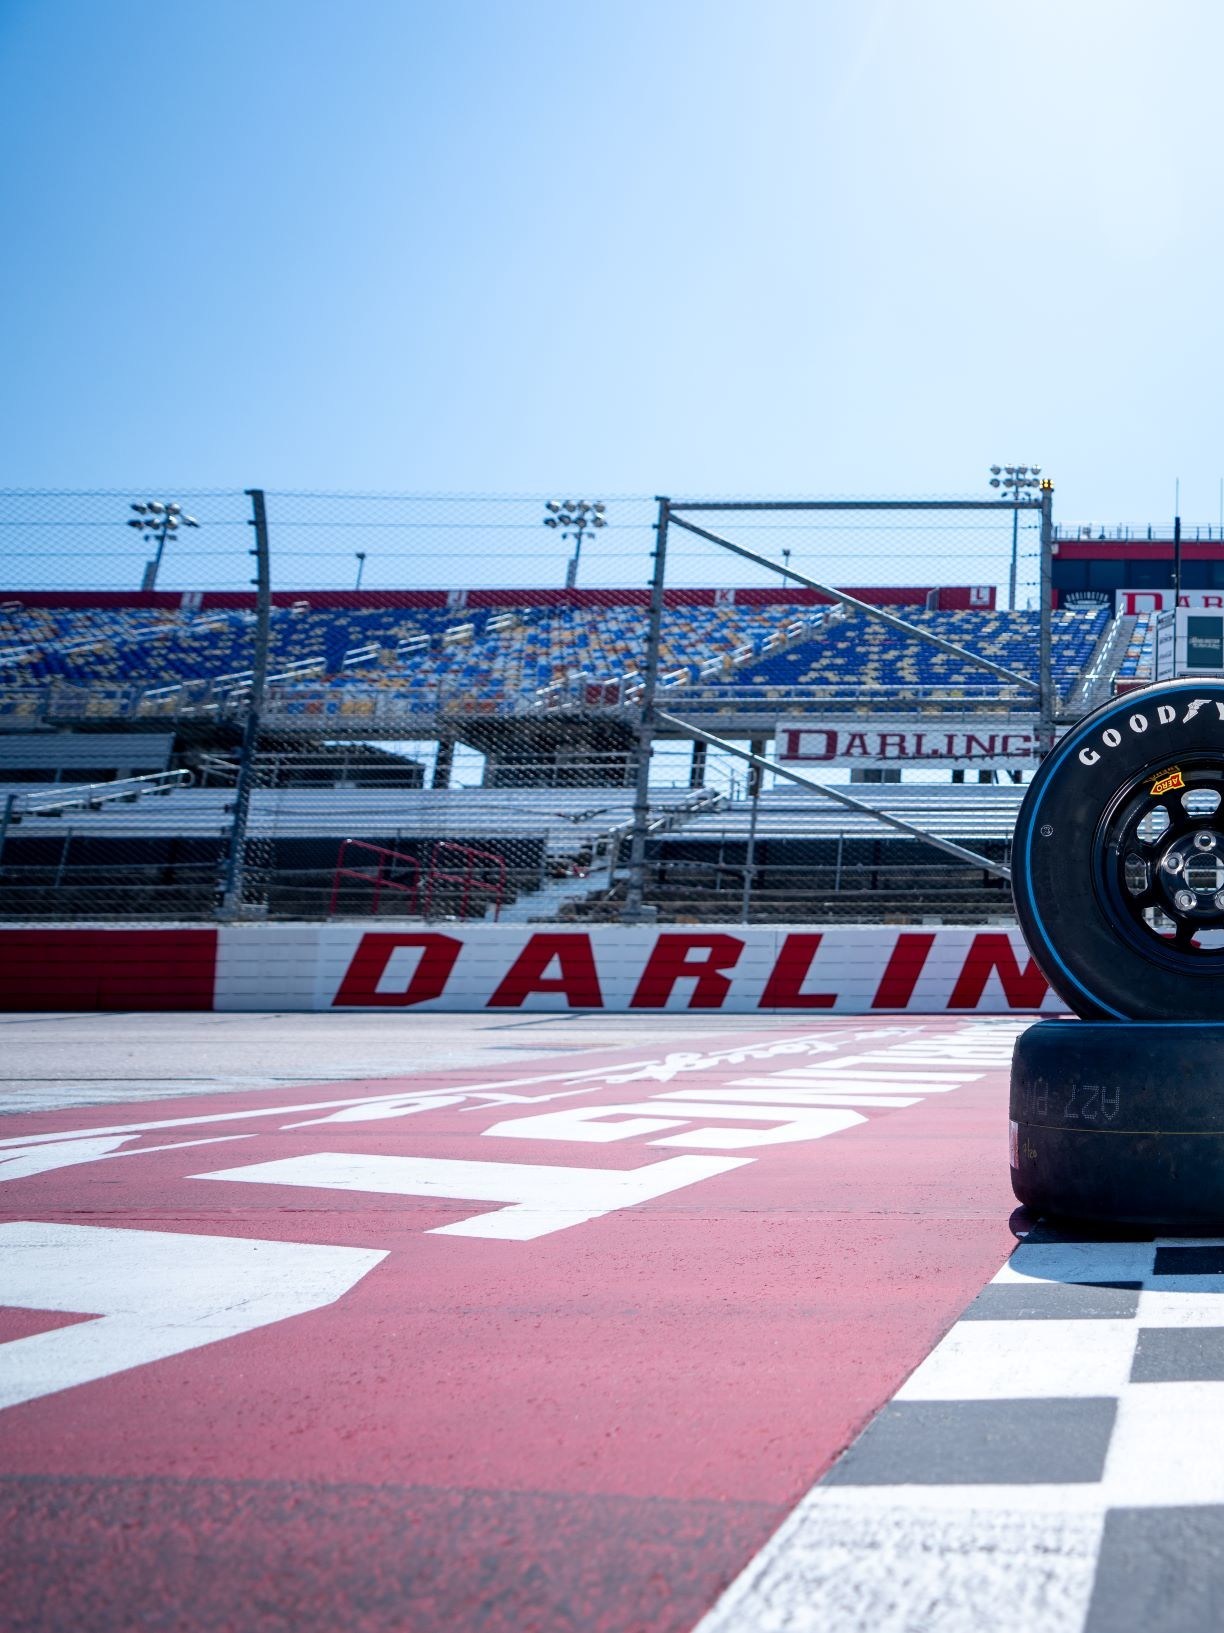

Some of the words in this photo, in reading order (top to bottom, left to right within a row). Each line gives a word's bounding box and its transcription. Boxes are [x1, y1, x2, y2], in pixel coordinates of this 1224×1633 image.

[718, 590, 730, 602] K
[975, 586, 985, 599] L
[779, 728, 1062, 761] DARLING
[1156, 777, 1179, 792] AERO
[1063, 1084, 1121, 1121] A27
